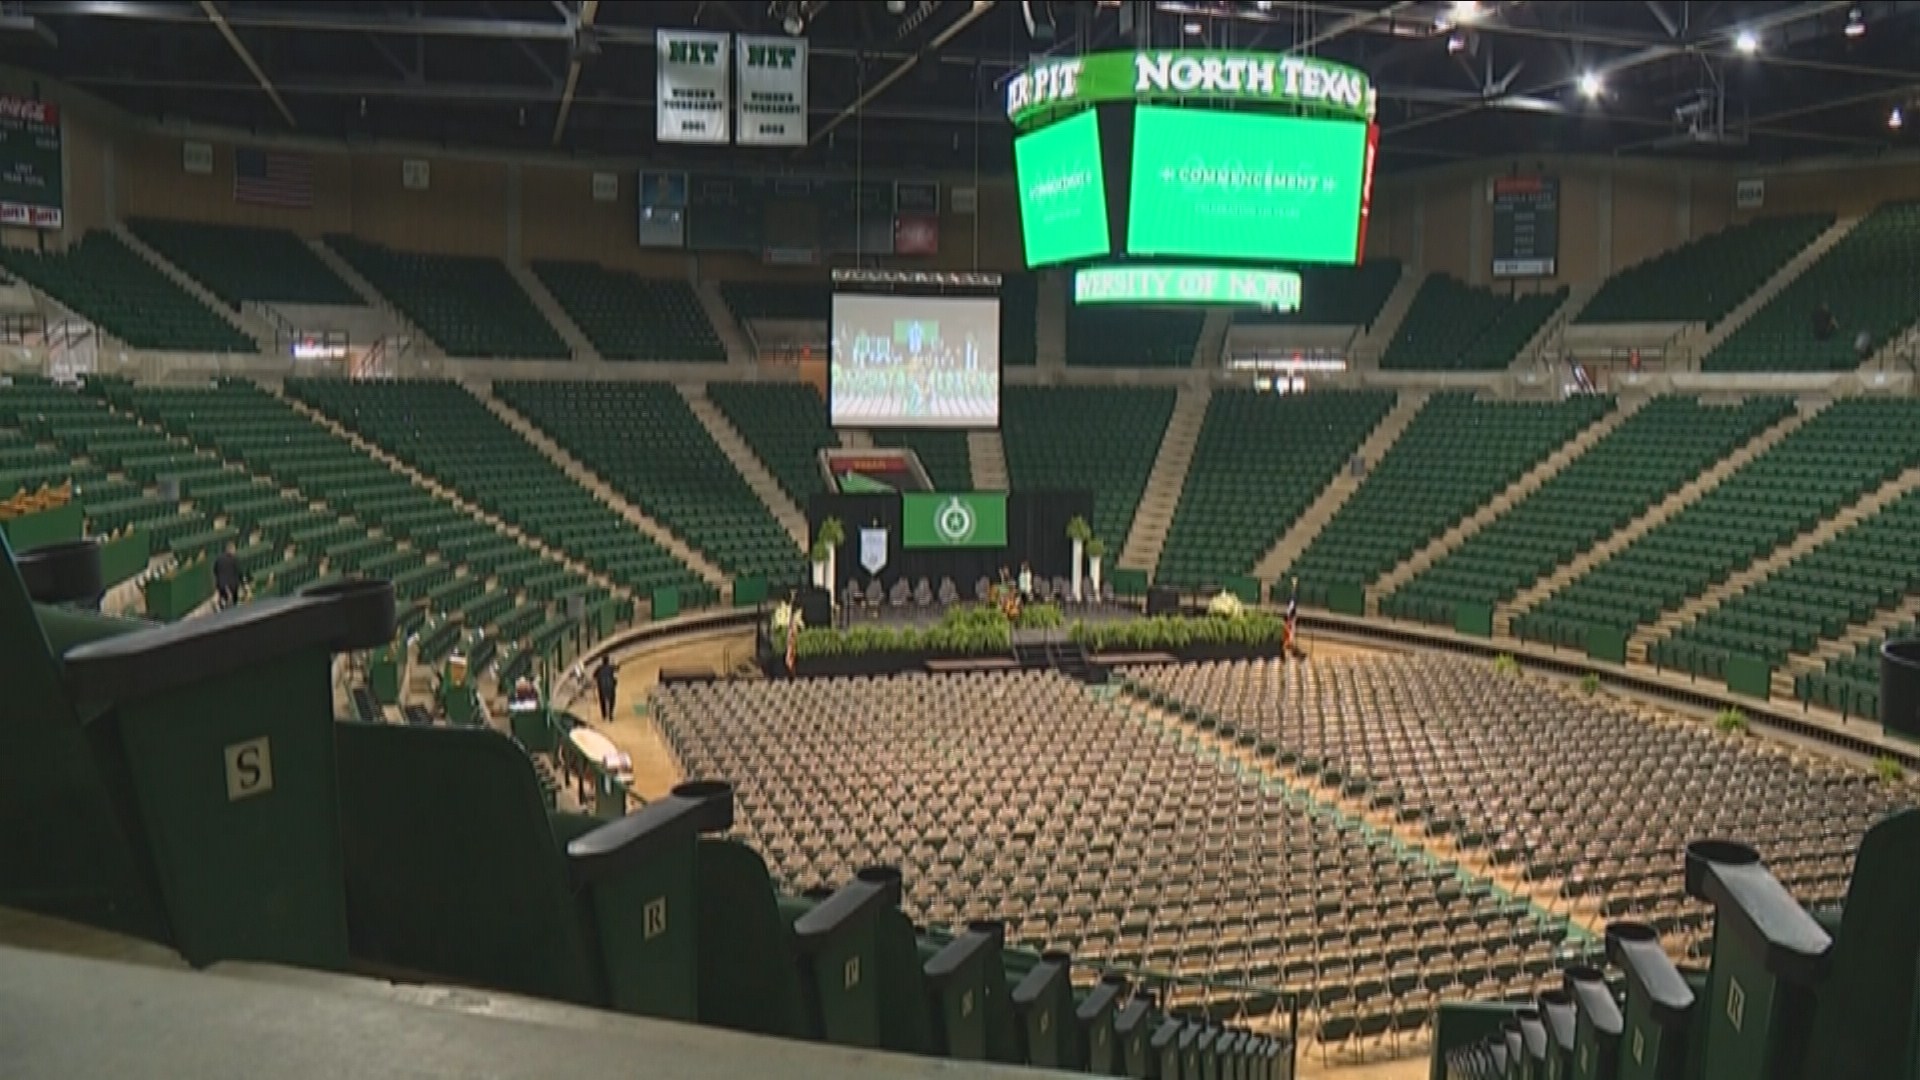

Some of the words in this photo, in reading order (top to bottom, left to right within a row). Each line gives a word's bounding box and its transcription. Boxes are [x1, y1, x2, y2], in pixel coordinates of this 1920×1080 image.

[669, 40, 718, 64] NIT
[748, 44, 796, 69] NIT
[1034, 60, 1082, 103] PIT
[1178, 166, 1319, 194] COMMENCEMENT
[236, 746, 261, 790] S
[648, 903, 662, 934] R
